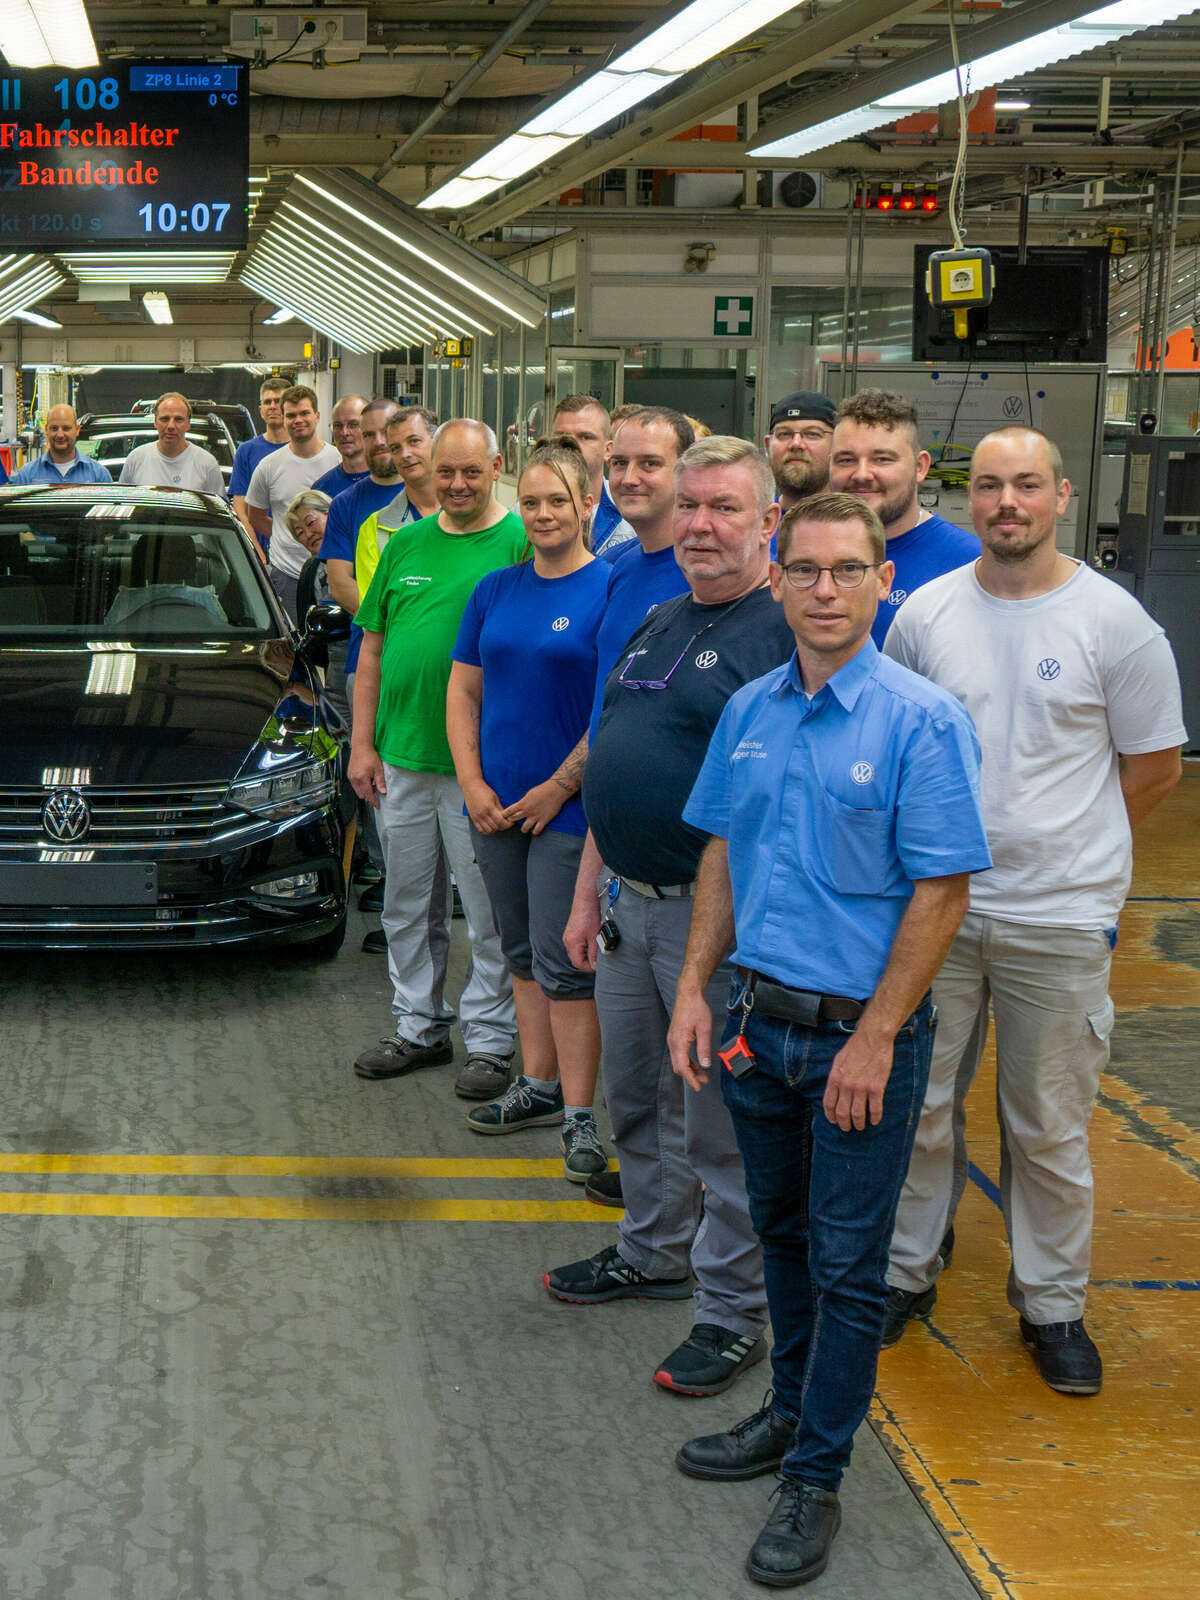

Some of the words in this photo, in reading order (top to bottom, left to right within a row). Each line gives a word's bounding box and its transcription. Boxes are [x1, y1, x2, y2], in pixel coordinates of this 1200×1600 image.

[144, 73, 172, 87] ZP8
[176, 73, 209, 87] Linie
[213, 73, 222, 87] 2
[53, 77, 120, 110] 108
[208, 93, 217, 106] 0
[17, 161, 160, 186] Bandende
[28, 214, 82, 232] 120.0
[89, 219, 100, 232] s
[137, 203, 231, 233] 10:07
[43, 789, 90, 840] VW
